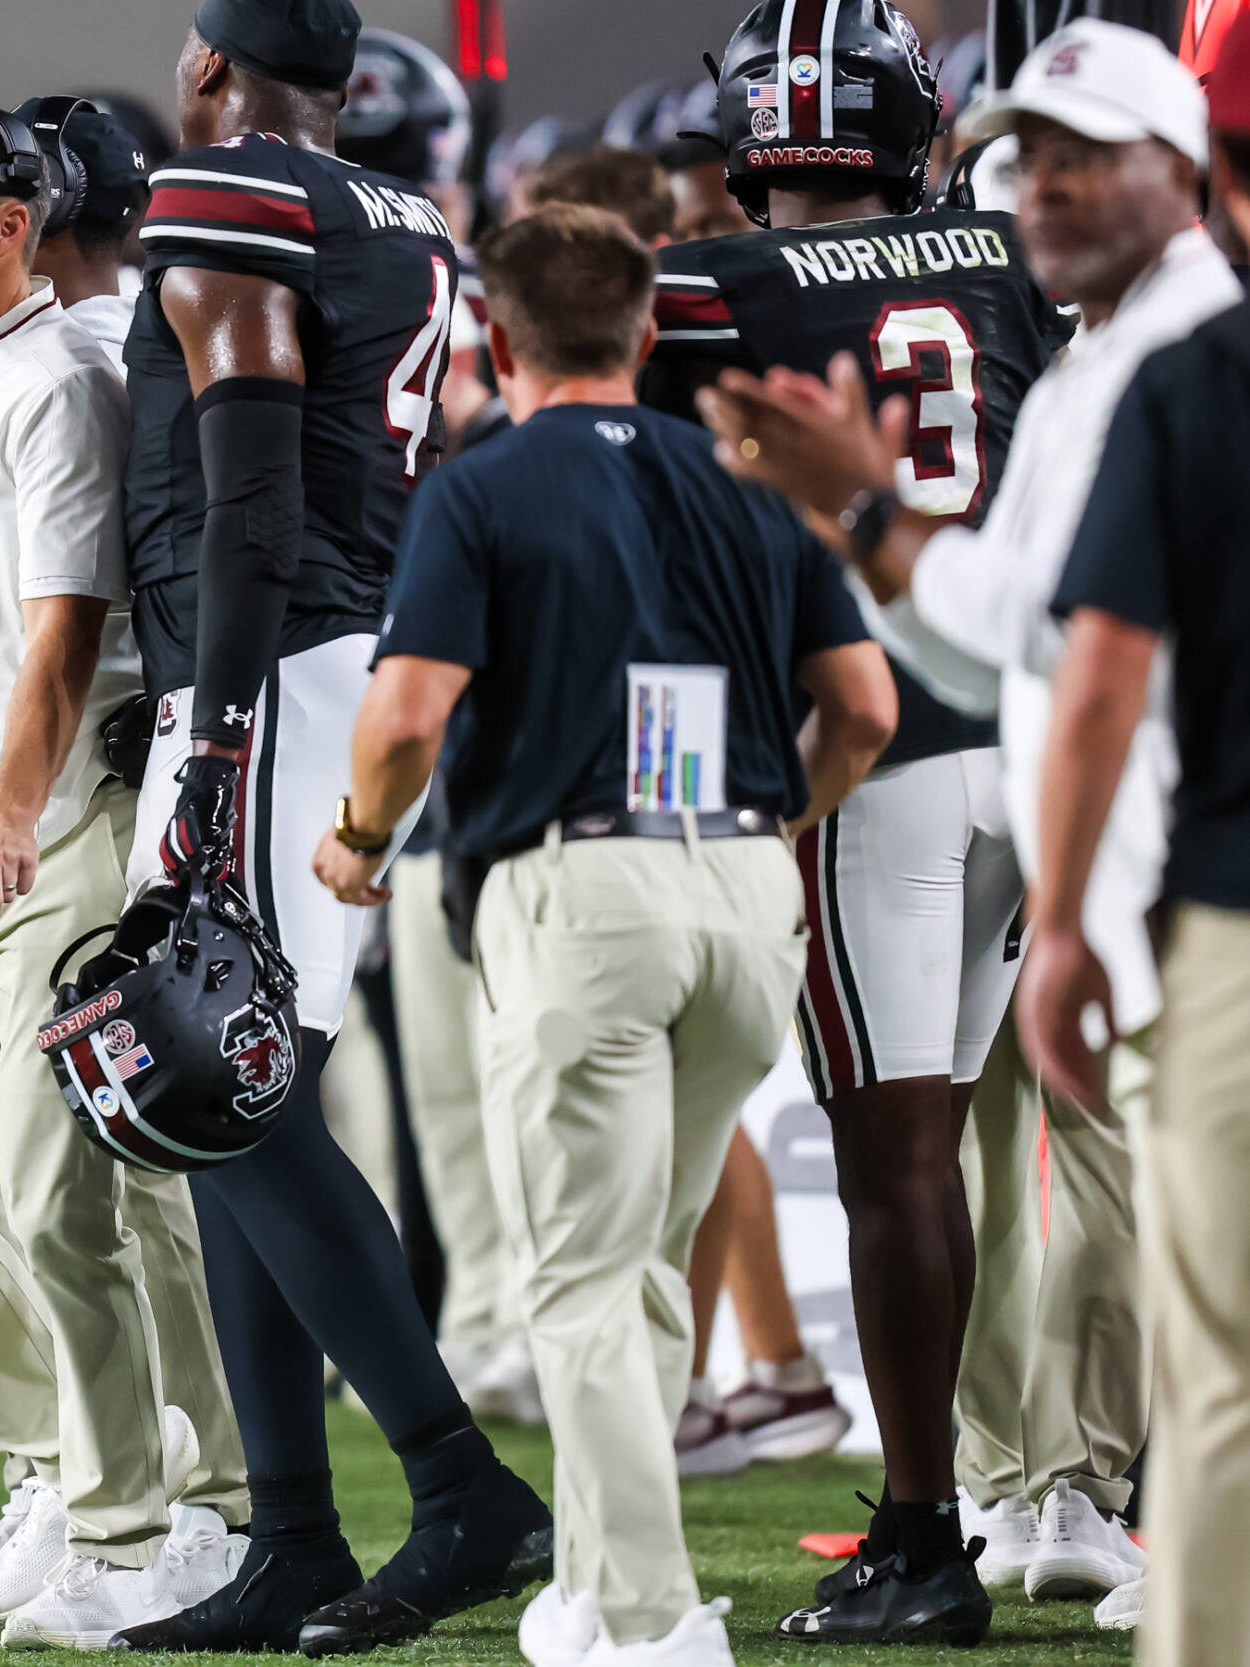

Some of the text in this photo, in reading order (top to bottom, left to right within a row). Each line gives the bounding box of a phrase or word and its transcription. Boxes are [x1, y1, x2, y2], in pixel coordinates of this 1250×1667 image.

[747, 147, 874, 167] GAMECOCKS
[779, 228, 1009, 288] NORWOOD
[382, 254, 452, 488] 4
[869, 298, 986, 520] 3
